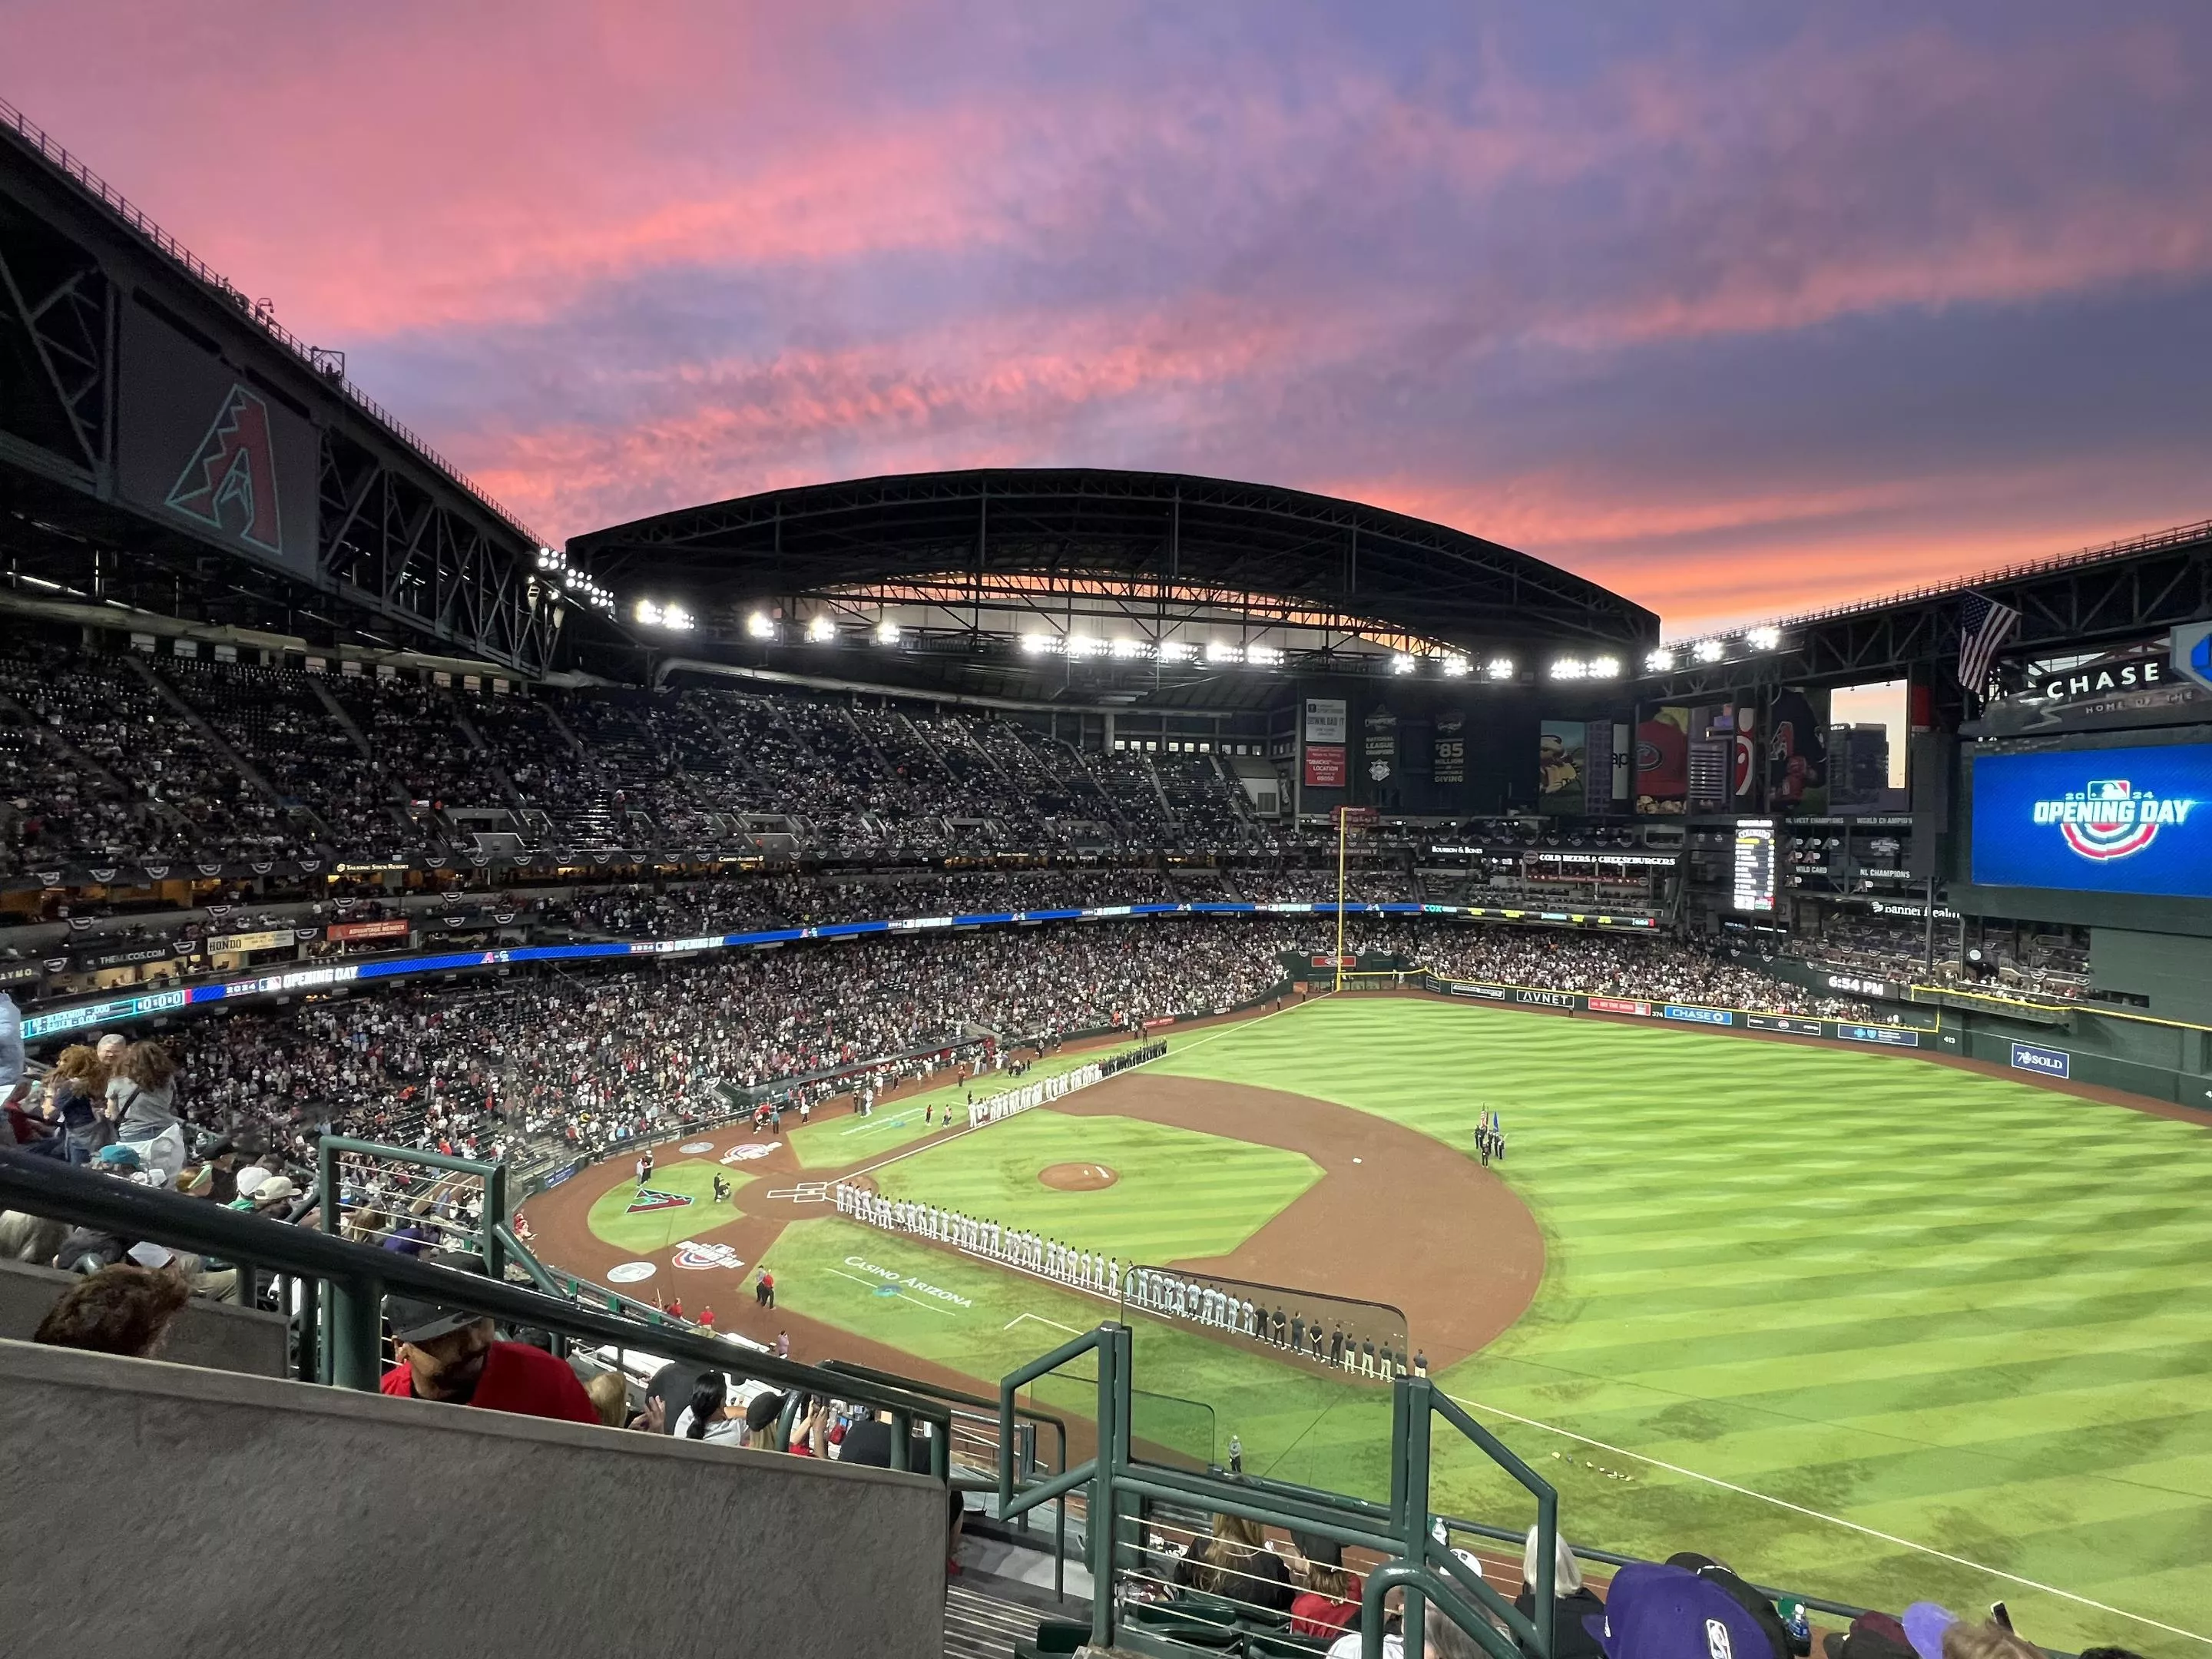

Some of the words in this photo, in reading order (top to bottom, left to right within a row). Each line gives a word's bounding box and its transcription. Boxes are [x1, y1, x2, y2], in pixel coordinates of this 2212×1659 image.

[2046, 663, 2160, 700] CHASE
[2086, 701, 2126, 714] HOME
[2166, 691, 2192, 704] THE
[2033, 801, 2135, 823] OPENING
[2140, 800, 2190, 823] DAY
[1563, 854, 1590, 863] BEERS
[1598, 856, 1676, 866] CHEESEBURGERS
[1870, 869, 1911, 878] CHAMPIONS
[208, 939, 242, 952] HONDO
[226, 983, 256, 994] 2024
[283, 969, 334, 988] OPENING
[334, 966, 359, 980] DAY
[1828, 975, 1859, 992] 6:54
[1863, 980, 1884, 996] PM
[1522, 992, 1568, 1005] AVNET
[1672, 1008, 1712, 1021] CHASE
[1944, 1035, 1955, 1044] 413
[844, 1256, 900, 1280] CASINO
[899, 1277, 972, 1308] ARIZONA
